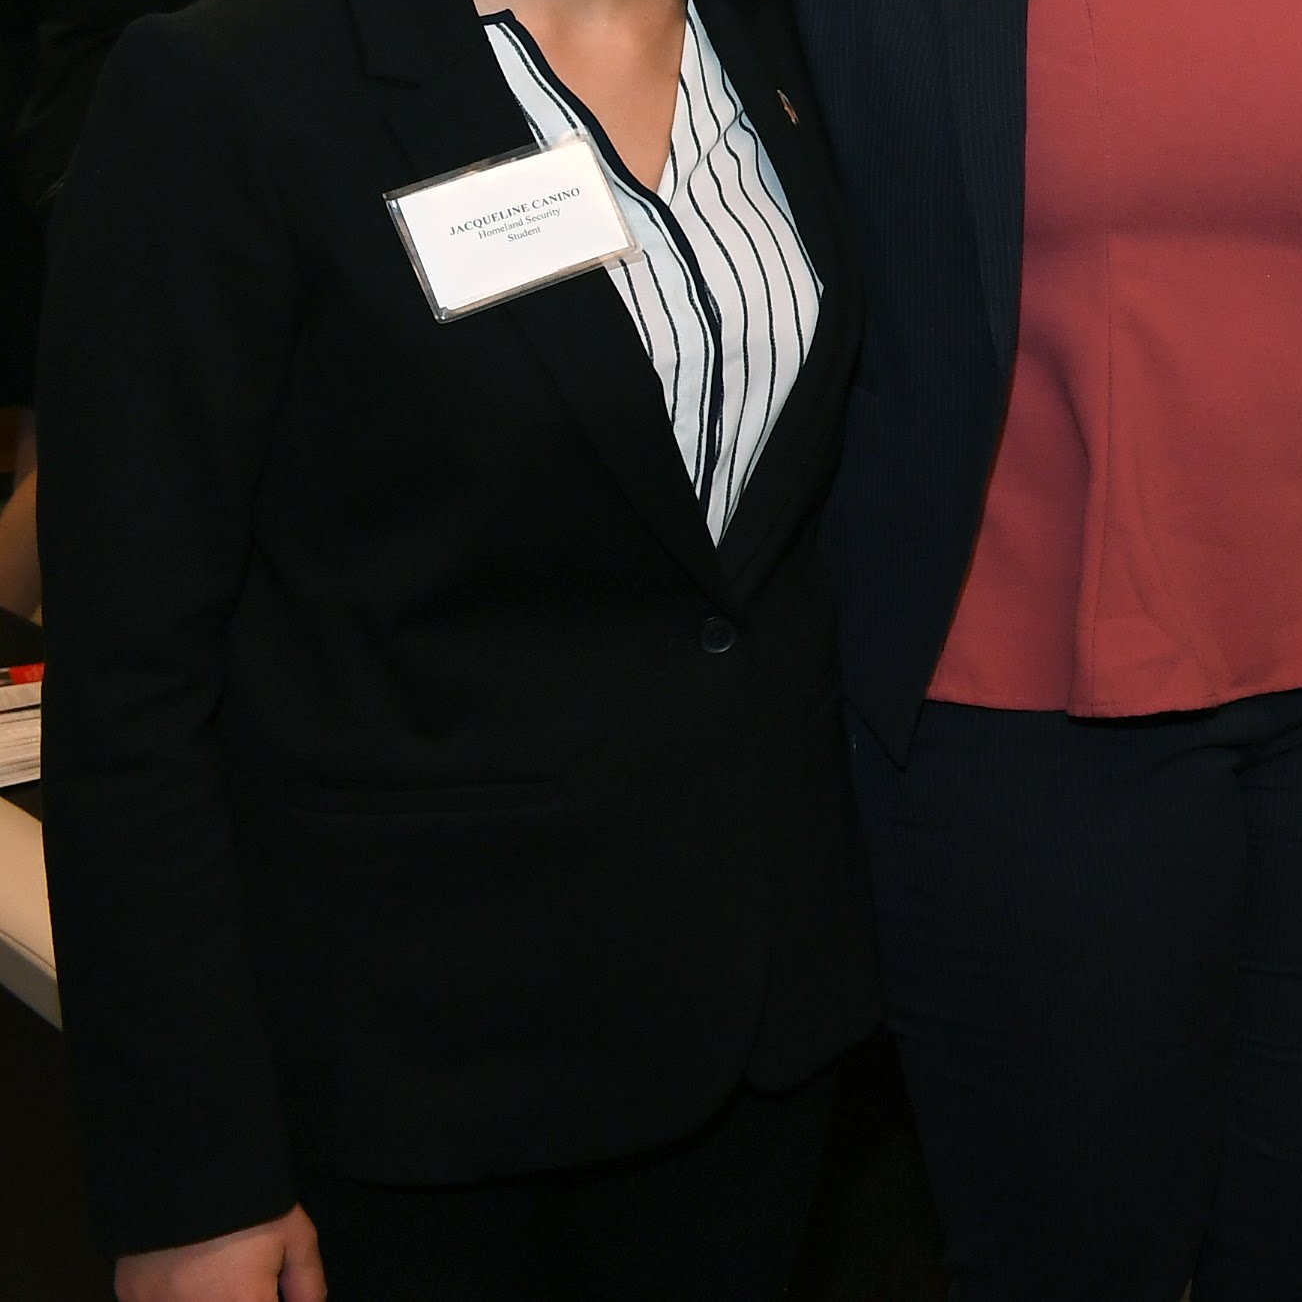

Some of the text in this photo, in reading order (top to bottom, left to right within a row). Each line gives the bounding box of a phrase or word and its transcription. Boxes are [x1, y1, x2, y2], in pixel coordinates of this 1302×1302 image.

[449, 188, 580, 235] JACQUELINE CANINO
[478, 208, 561, 239] Homeland Security
[508, 225, 540, 242] Student
